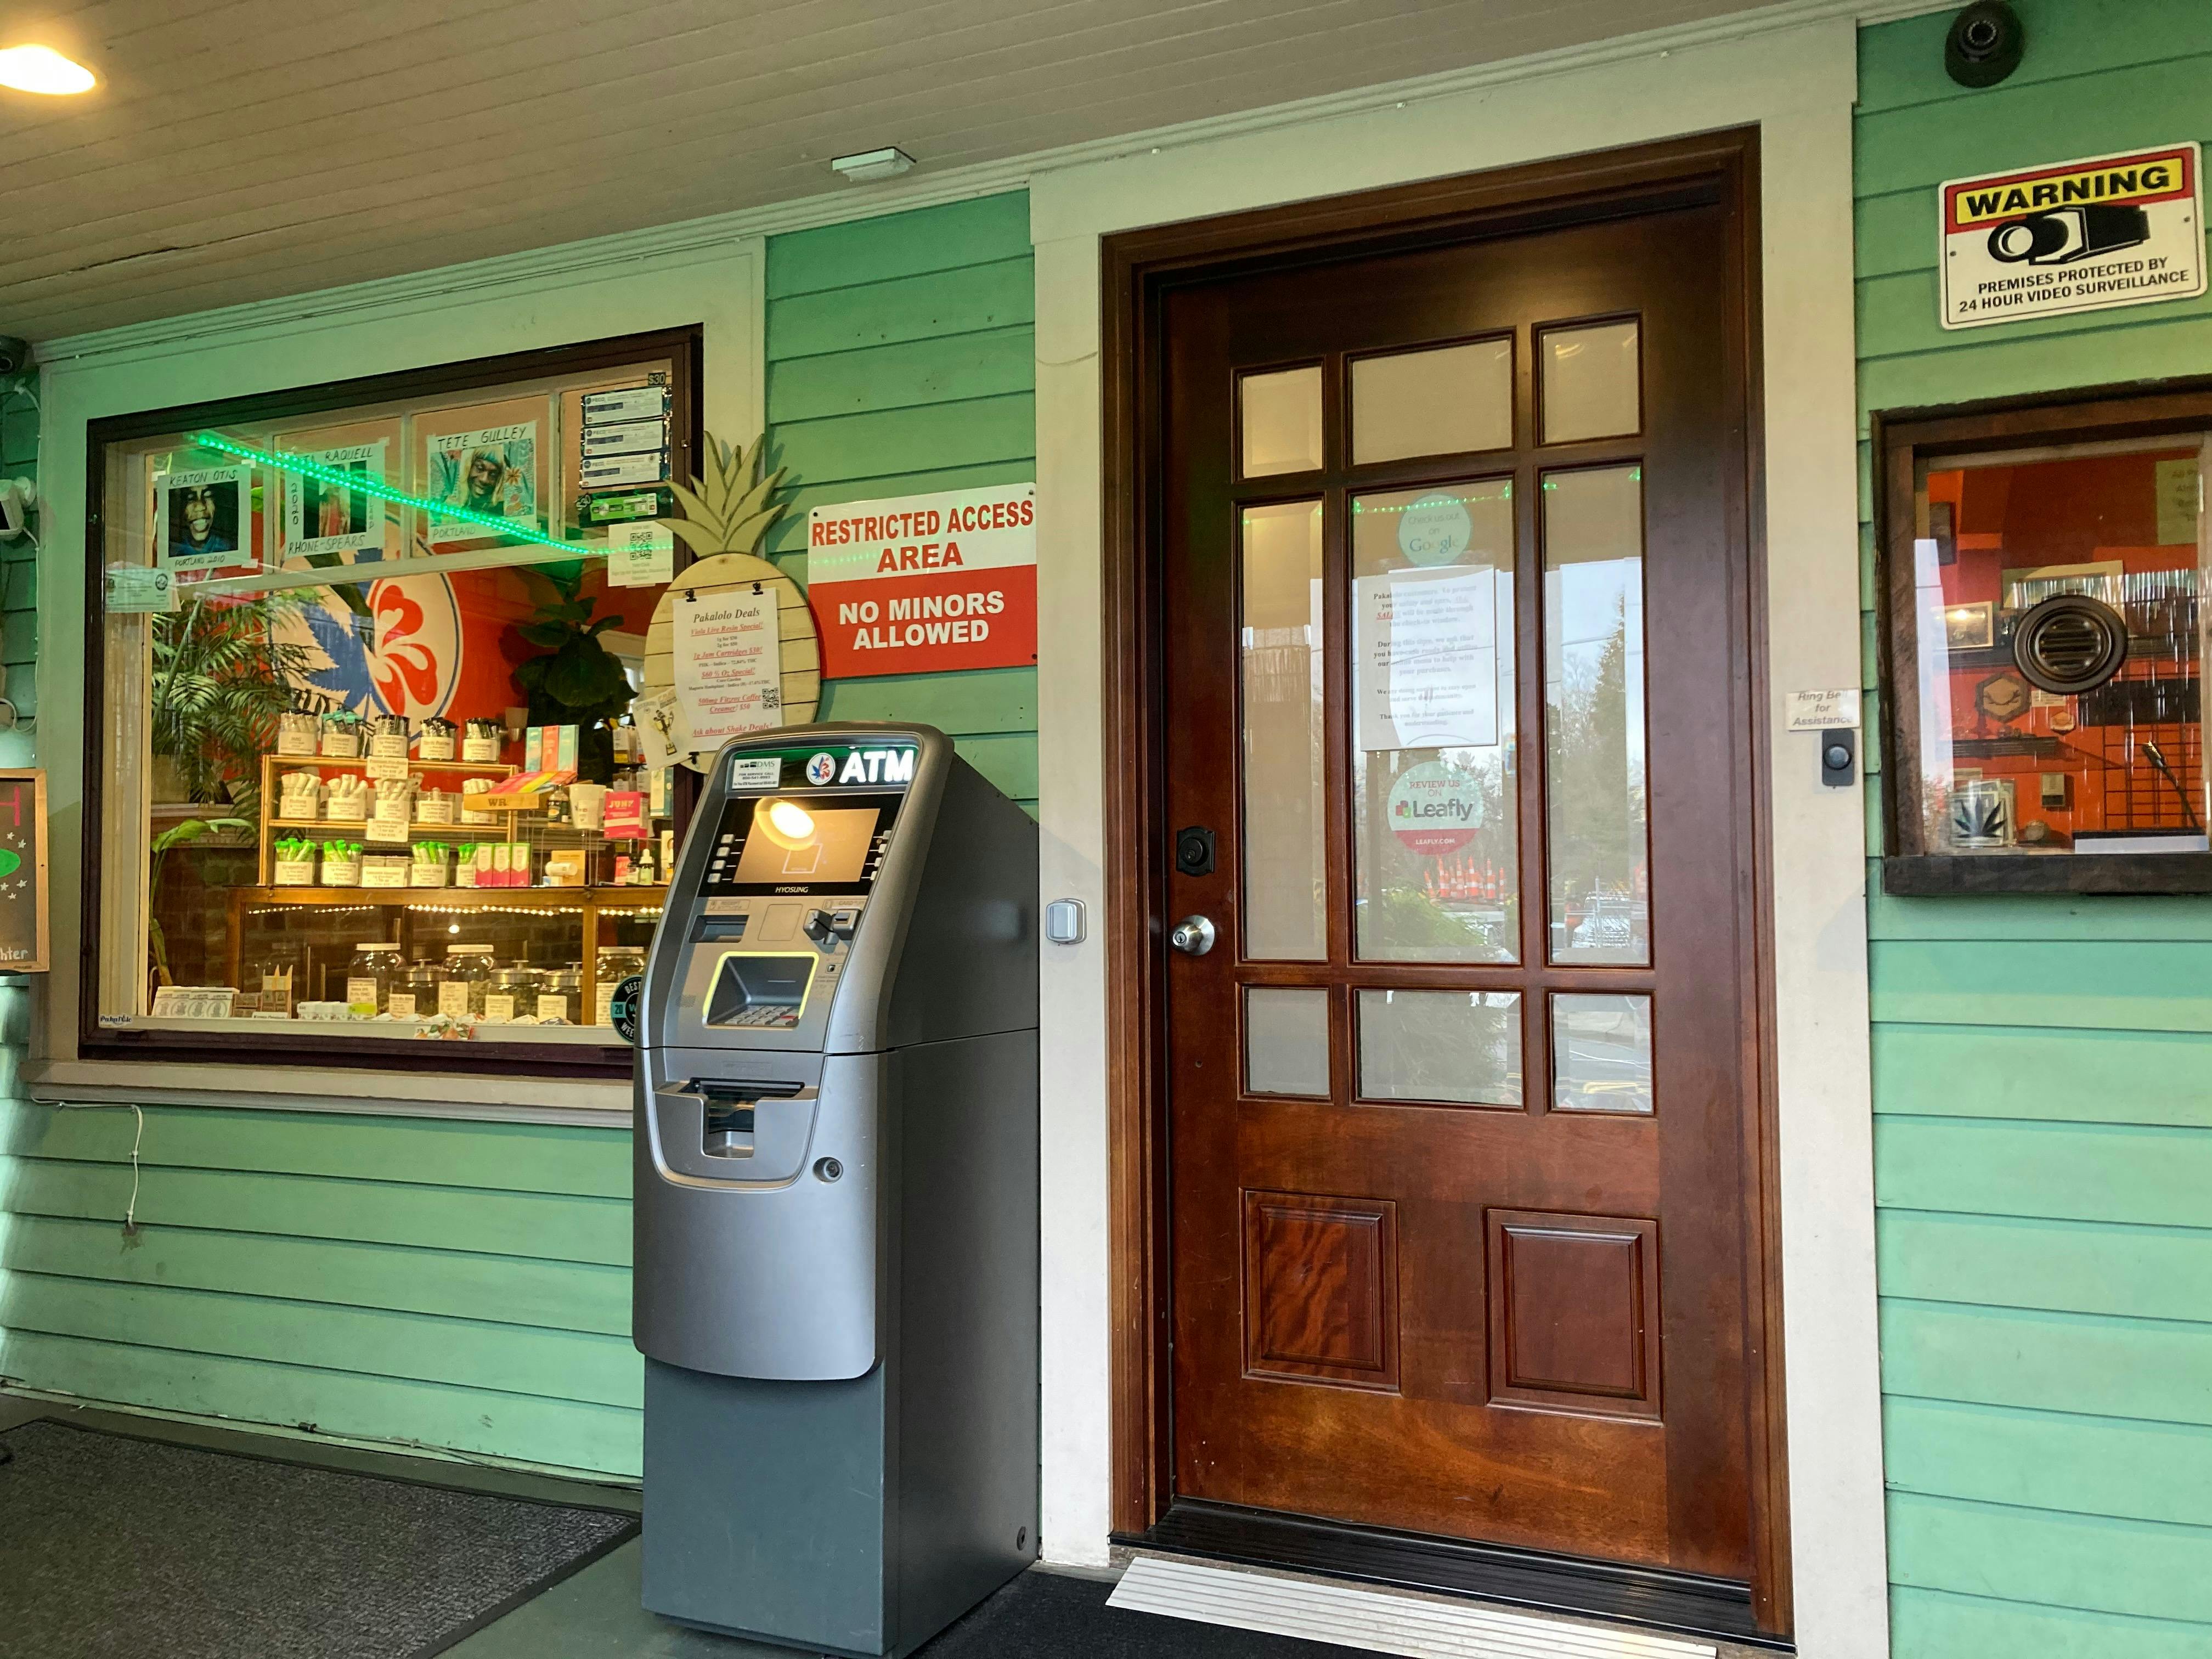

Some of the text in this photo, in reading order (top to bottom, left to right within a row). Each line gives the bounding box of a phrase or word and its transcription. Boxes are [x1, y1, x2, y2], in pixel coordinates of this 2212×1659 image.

[1966, 166, 2169, 217] WARNING
[1978, 257, 2168, 294] PREMISES PROTECTED BY
[1959, 269, 2189, 313] 24 HOUR VIDEO SURVEILLANCE
[648, 374, 665, 384] $30
[438, 426, 527, 450] TETE GULLEY
[325, 447, 373, 461] RAQUELL
[170, 470, 238, 486] KEATON OTIS
[812, 500, 1034, 546] RESTRICTED ACCESS
[433, 526, 476, 538] PORTLAND
[288, 535, 365, 554] RHONE-SPEARS
[175, 555, 225, 567] PORTLAND 2010
[877, 542, 963, 573] AREA
[693, 607, 760, 623] Pakalolo Deals
[839, 591, 1005, 625] NO MINORS
[853, 619, 989, 650] ALLOWED
[716, 648, 748, 657] Cartridges
[1797, 691, 1824, 702] Ring
[1815, 704, 1831, 712] for
[705, 727, 725, 735] about
[748, 722, 772, 732] Deals!
[1793, 716, 1852, 726] Assistance
[839, 749, 914, 783] ATM
[1409, 780, 1445, 789] REVIEW
[1413, 798, 1473, 821] Leafly
[615, 1005, 623, 1014] 20
[621, 1022, 634, 1037] WEE
